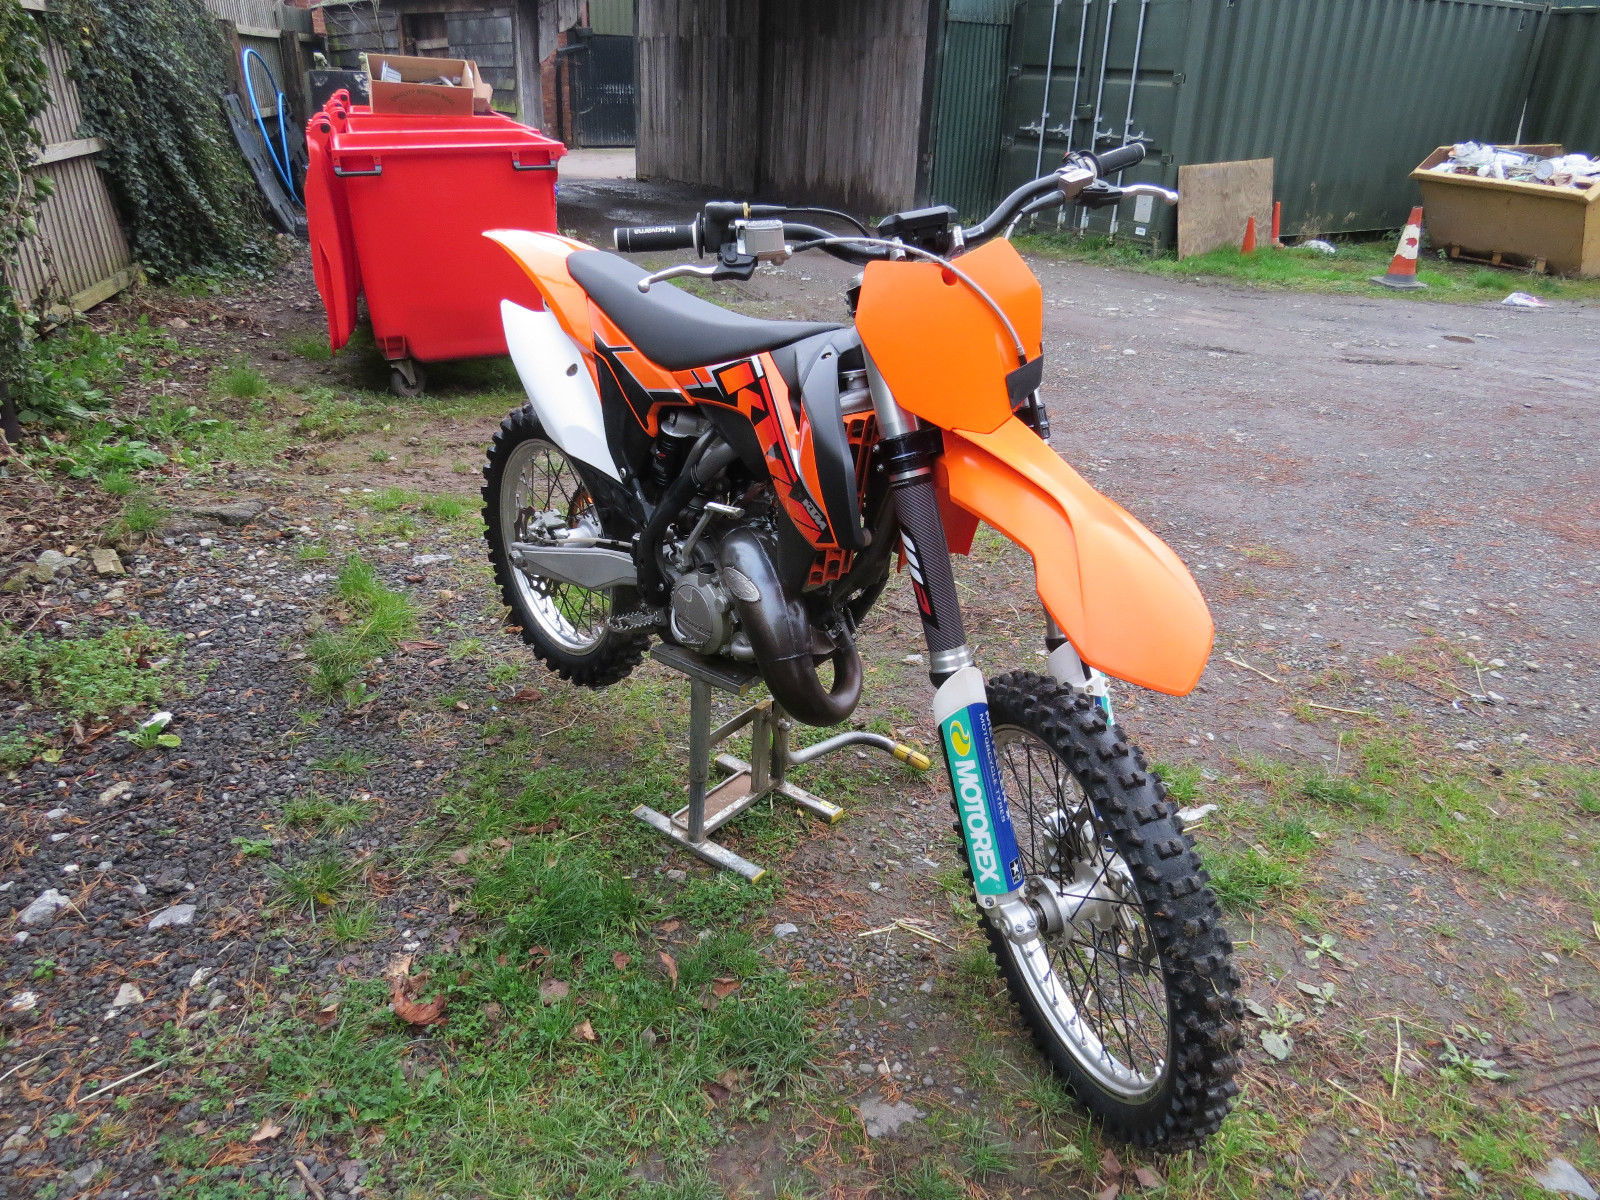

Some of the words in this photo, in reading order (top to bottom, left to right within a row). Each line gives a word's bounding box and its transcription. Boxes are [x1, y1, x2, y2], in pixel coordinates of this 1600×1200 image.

[633, 226, 677, 236] Husqvarna
[801, 498, 828, 531] KTM
[979, 713, 998, 787] MOTORCYCLE
[954, 759, 1000, 883] MOTOREX
